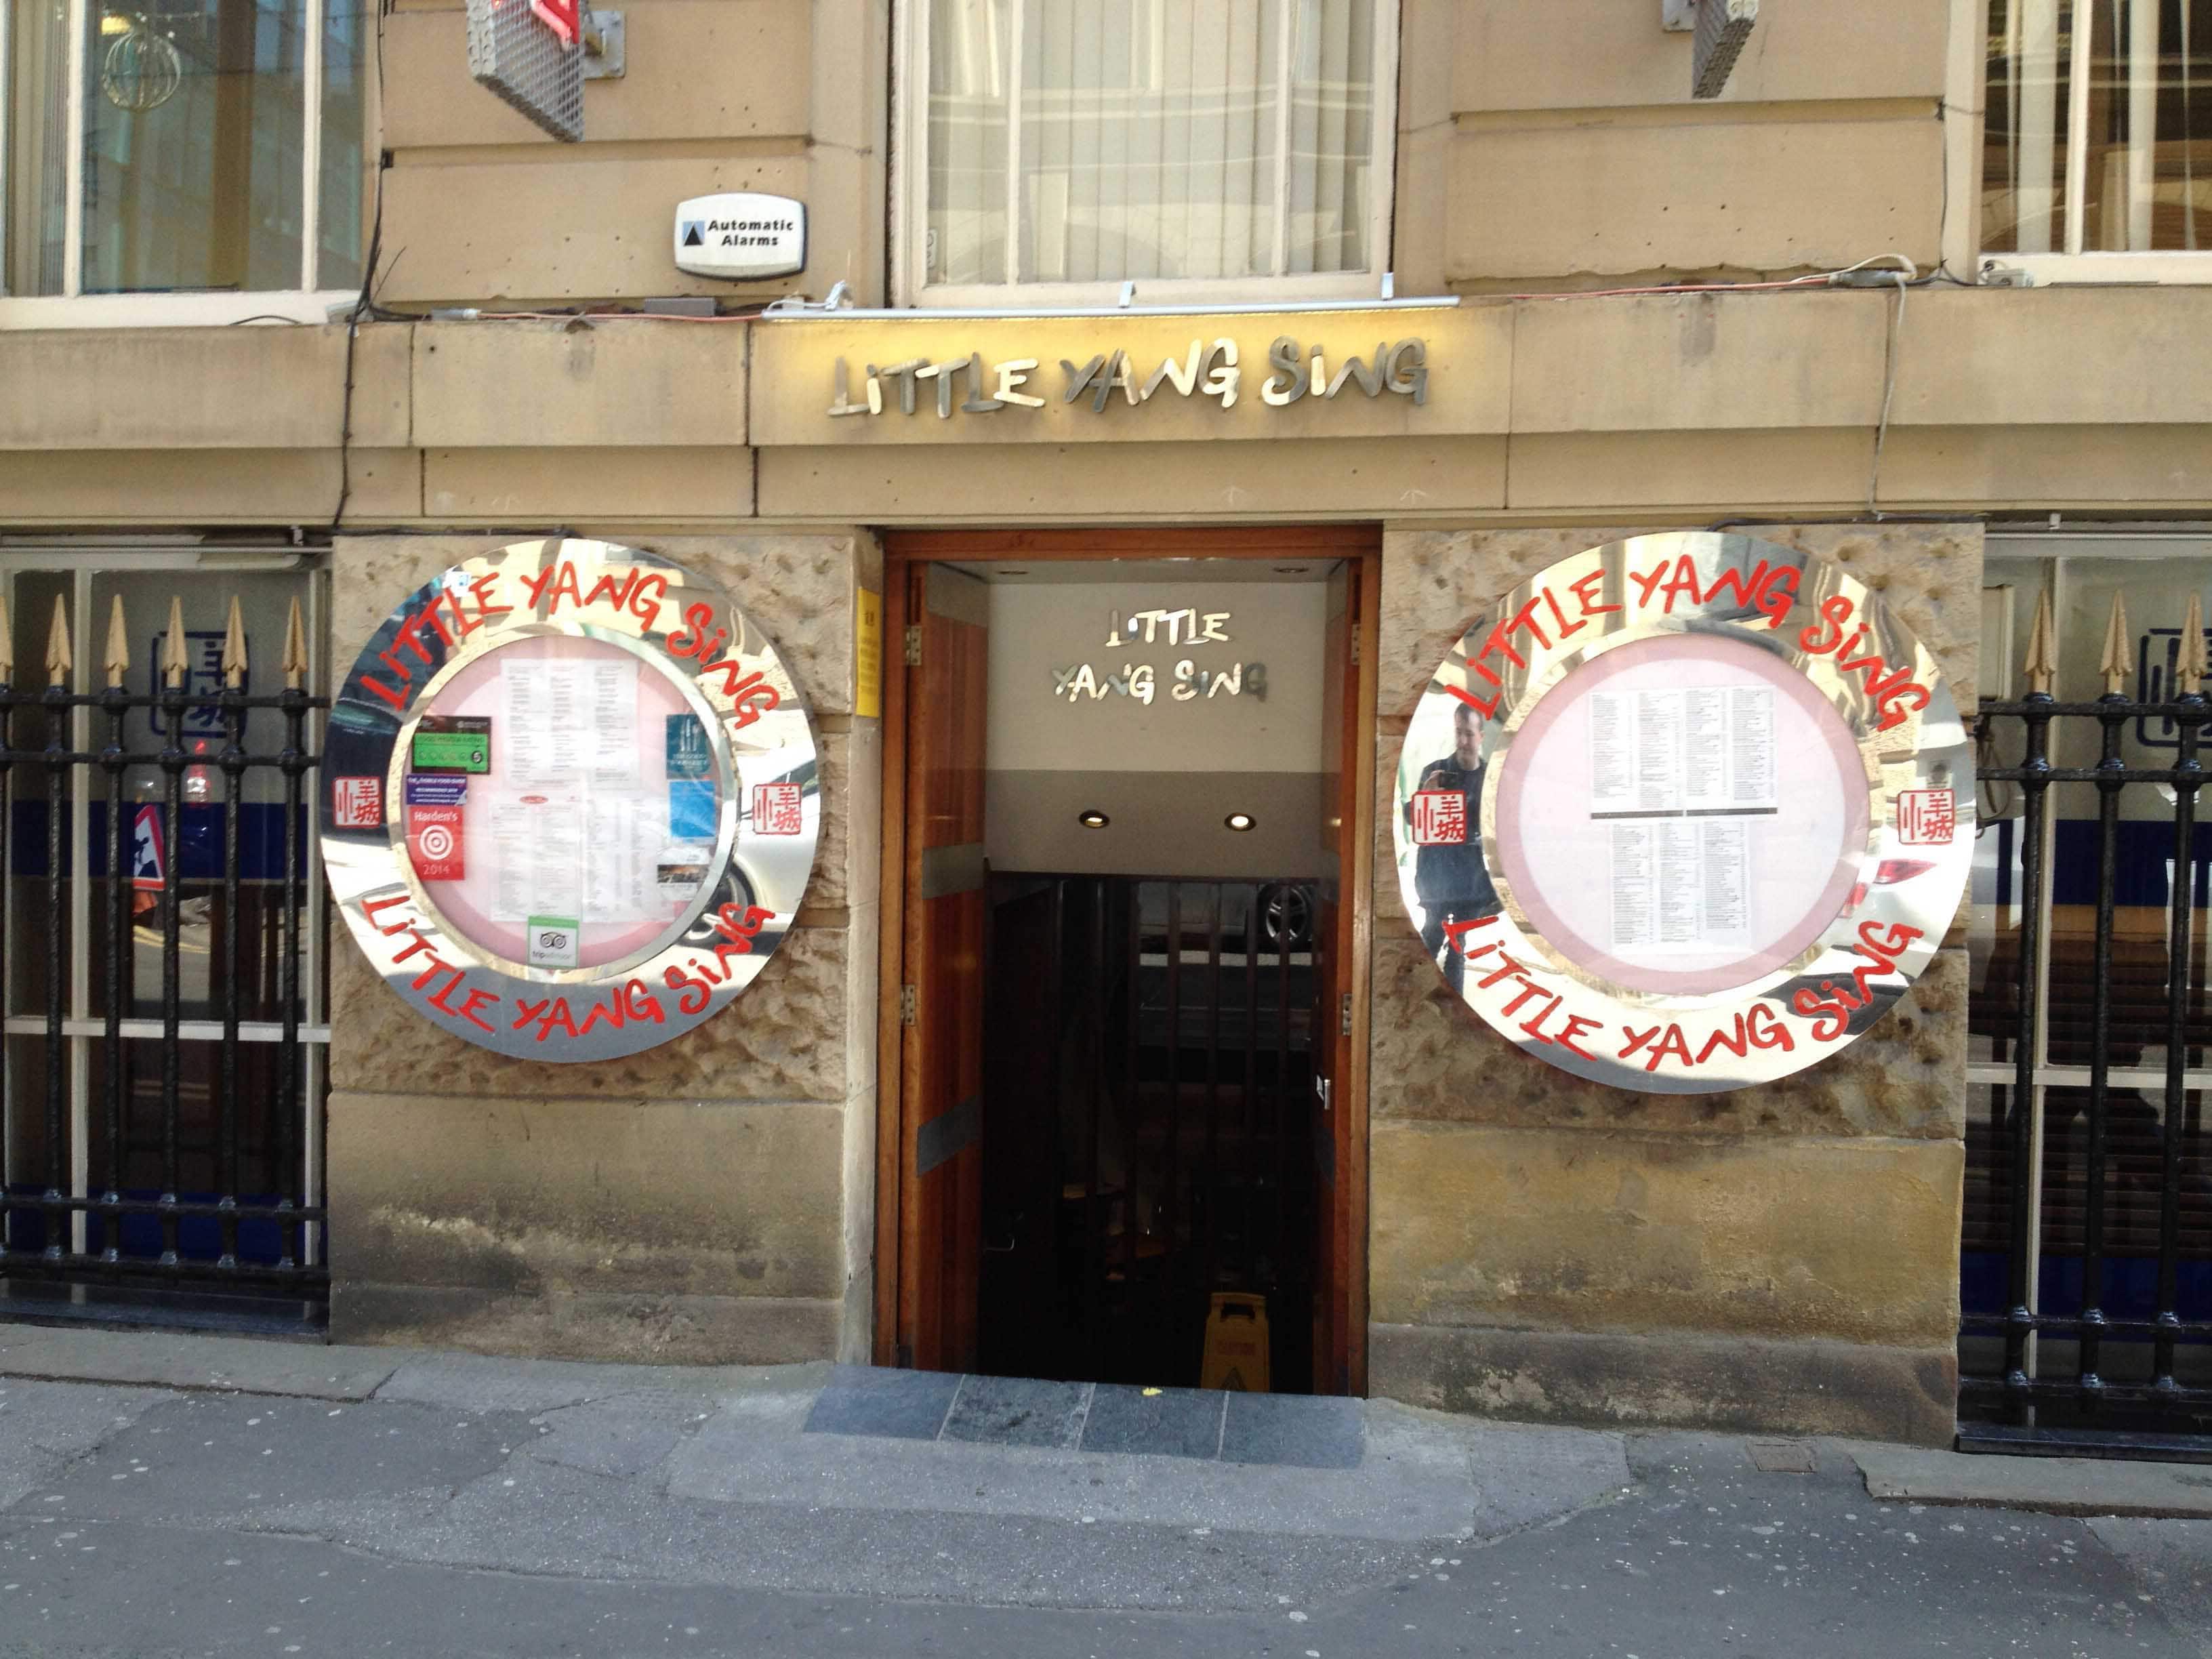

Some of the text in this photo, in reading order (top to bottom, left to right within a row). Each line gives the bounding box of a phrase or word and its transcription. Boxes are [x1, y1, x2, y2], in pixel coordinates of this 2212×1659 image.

[707, 219, 794, 231] Automatic
[720, 234, 779, 246] Alarms
[1059, 337, 1242, 414] YANG
[520, 560, 667, 632] YANG
[1629, 554, 1801, 629] YANG
[1051, 663, 1155, 706] YANG
[413, 810, 459, 822] Harden's
[422, 863, 451, 876] 2014
[512, 979, 665, 1042] YANG
[1617, 1004, 1795, 1071] YANG
